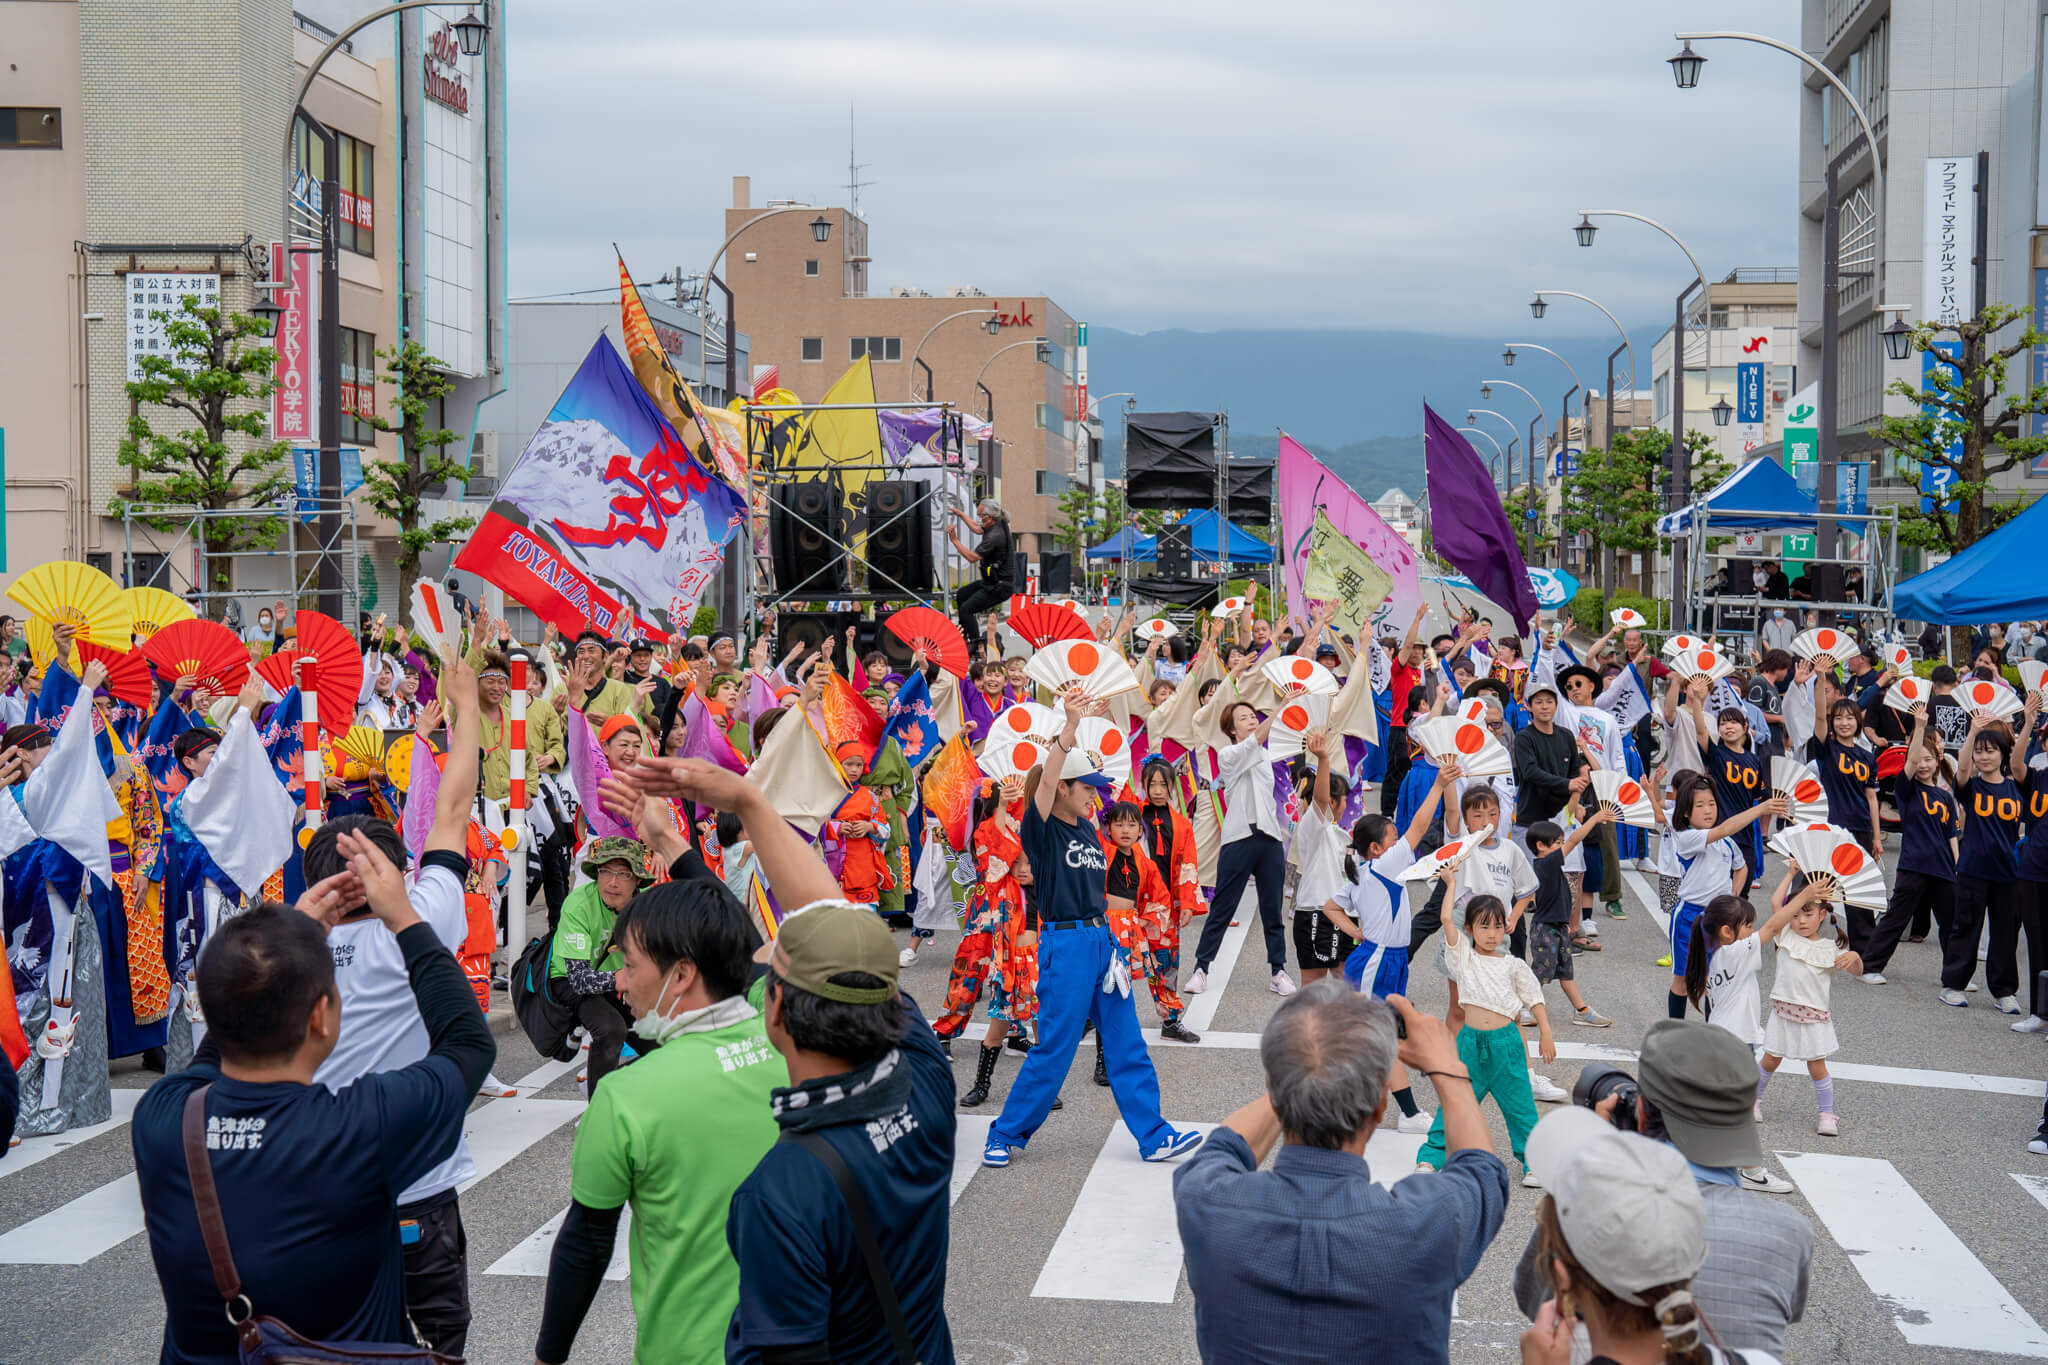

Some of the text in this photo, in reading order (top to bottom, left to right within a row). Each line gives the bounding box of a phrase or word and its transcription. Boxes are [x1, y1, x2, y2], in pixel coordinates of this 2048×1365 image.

[423, 53, 468, 113] Shimada
[1942, 162, 1956, 212] アプライド
[1941, 215, 1956, 272] マテリアルズ
[134, 278, 217, 289] 国公立大対策
[1940, 276, 1955, 313] ジャパン
[1749, 367, 1758, 419] NICE TV
[1974, 793, 2021, 823] UO!
